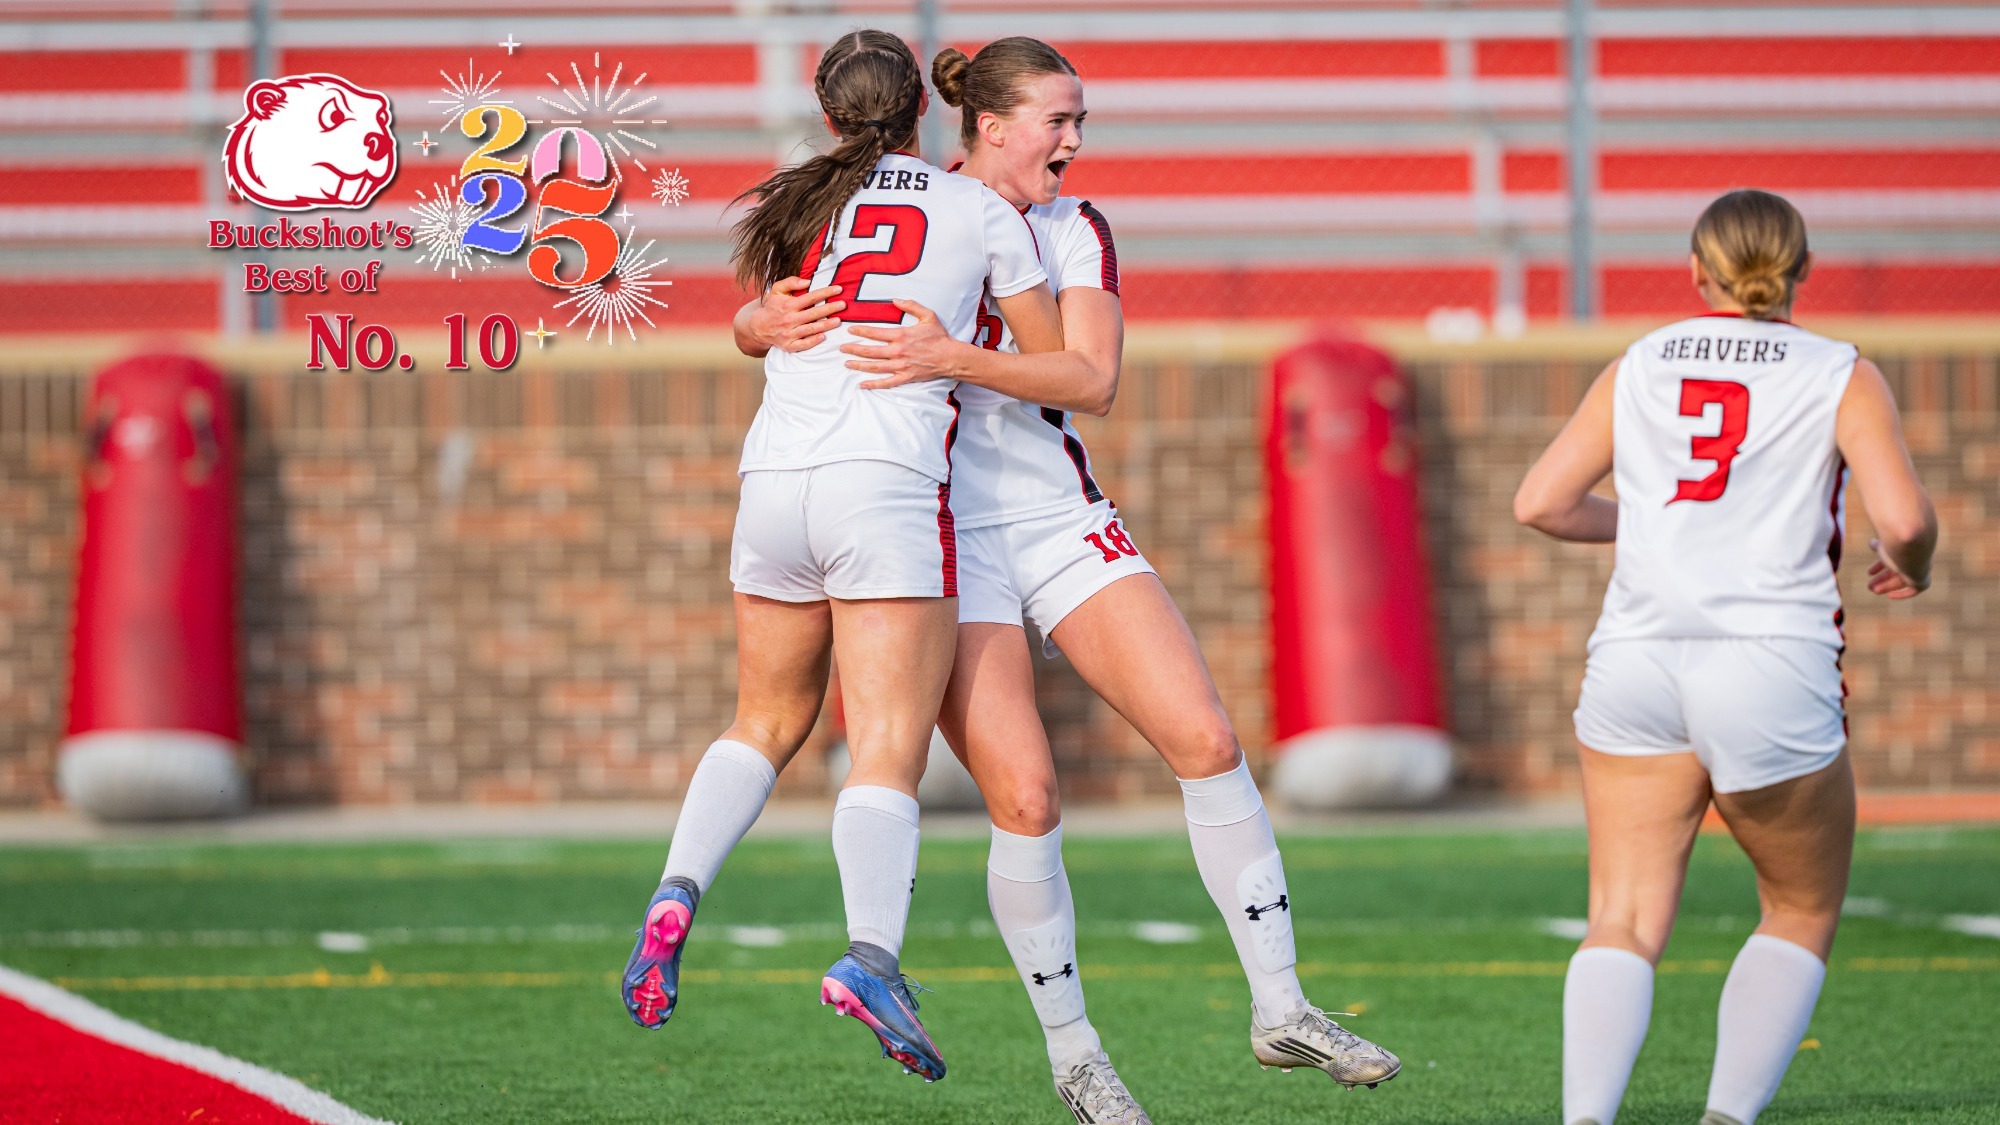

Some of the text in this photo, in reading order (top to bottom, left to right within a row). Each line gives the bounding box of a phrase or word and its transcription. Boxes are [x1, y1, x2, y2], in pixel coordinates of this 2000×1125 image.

[861, 170, 929, 191] VERS
[1661, 337, 1788, 363] BEAVERS
[1665, 378, 1750, 507] 3
[1083, 520, 1139, 563] 18
